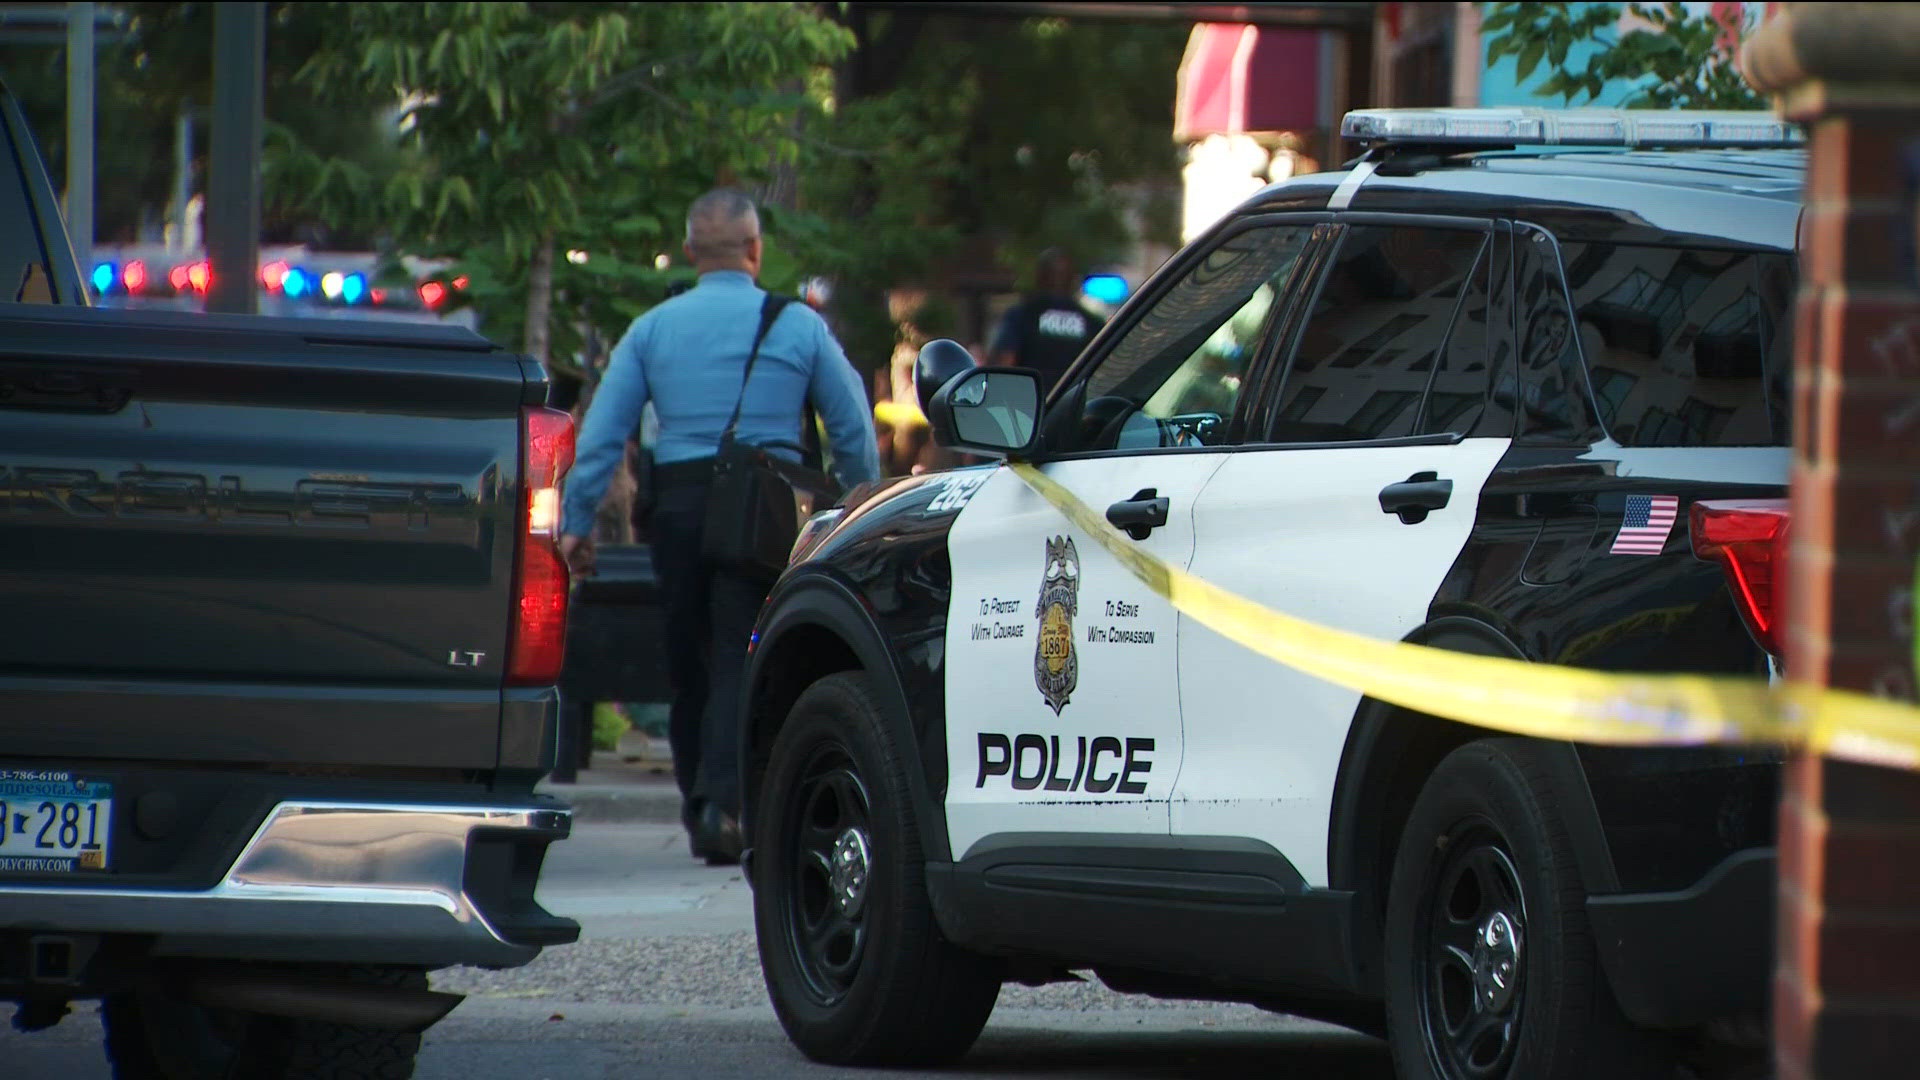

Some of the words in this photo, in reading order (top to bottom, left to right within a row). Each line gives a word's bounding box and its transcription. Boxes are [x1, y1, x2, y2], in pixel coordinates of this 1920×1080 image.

[1039, 309, 1085, 336] POLICE
[927, 474, 987, 511] 262
[449, 651, 486, 666] LT
[1044, 637, 1066, 655] 1867
[975, 732, 1155, 794] POLICE
